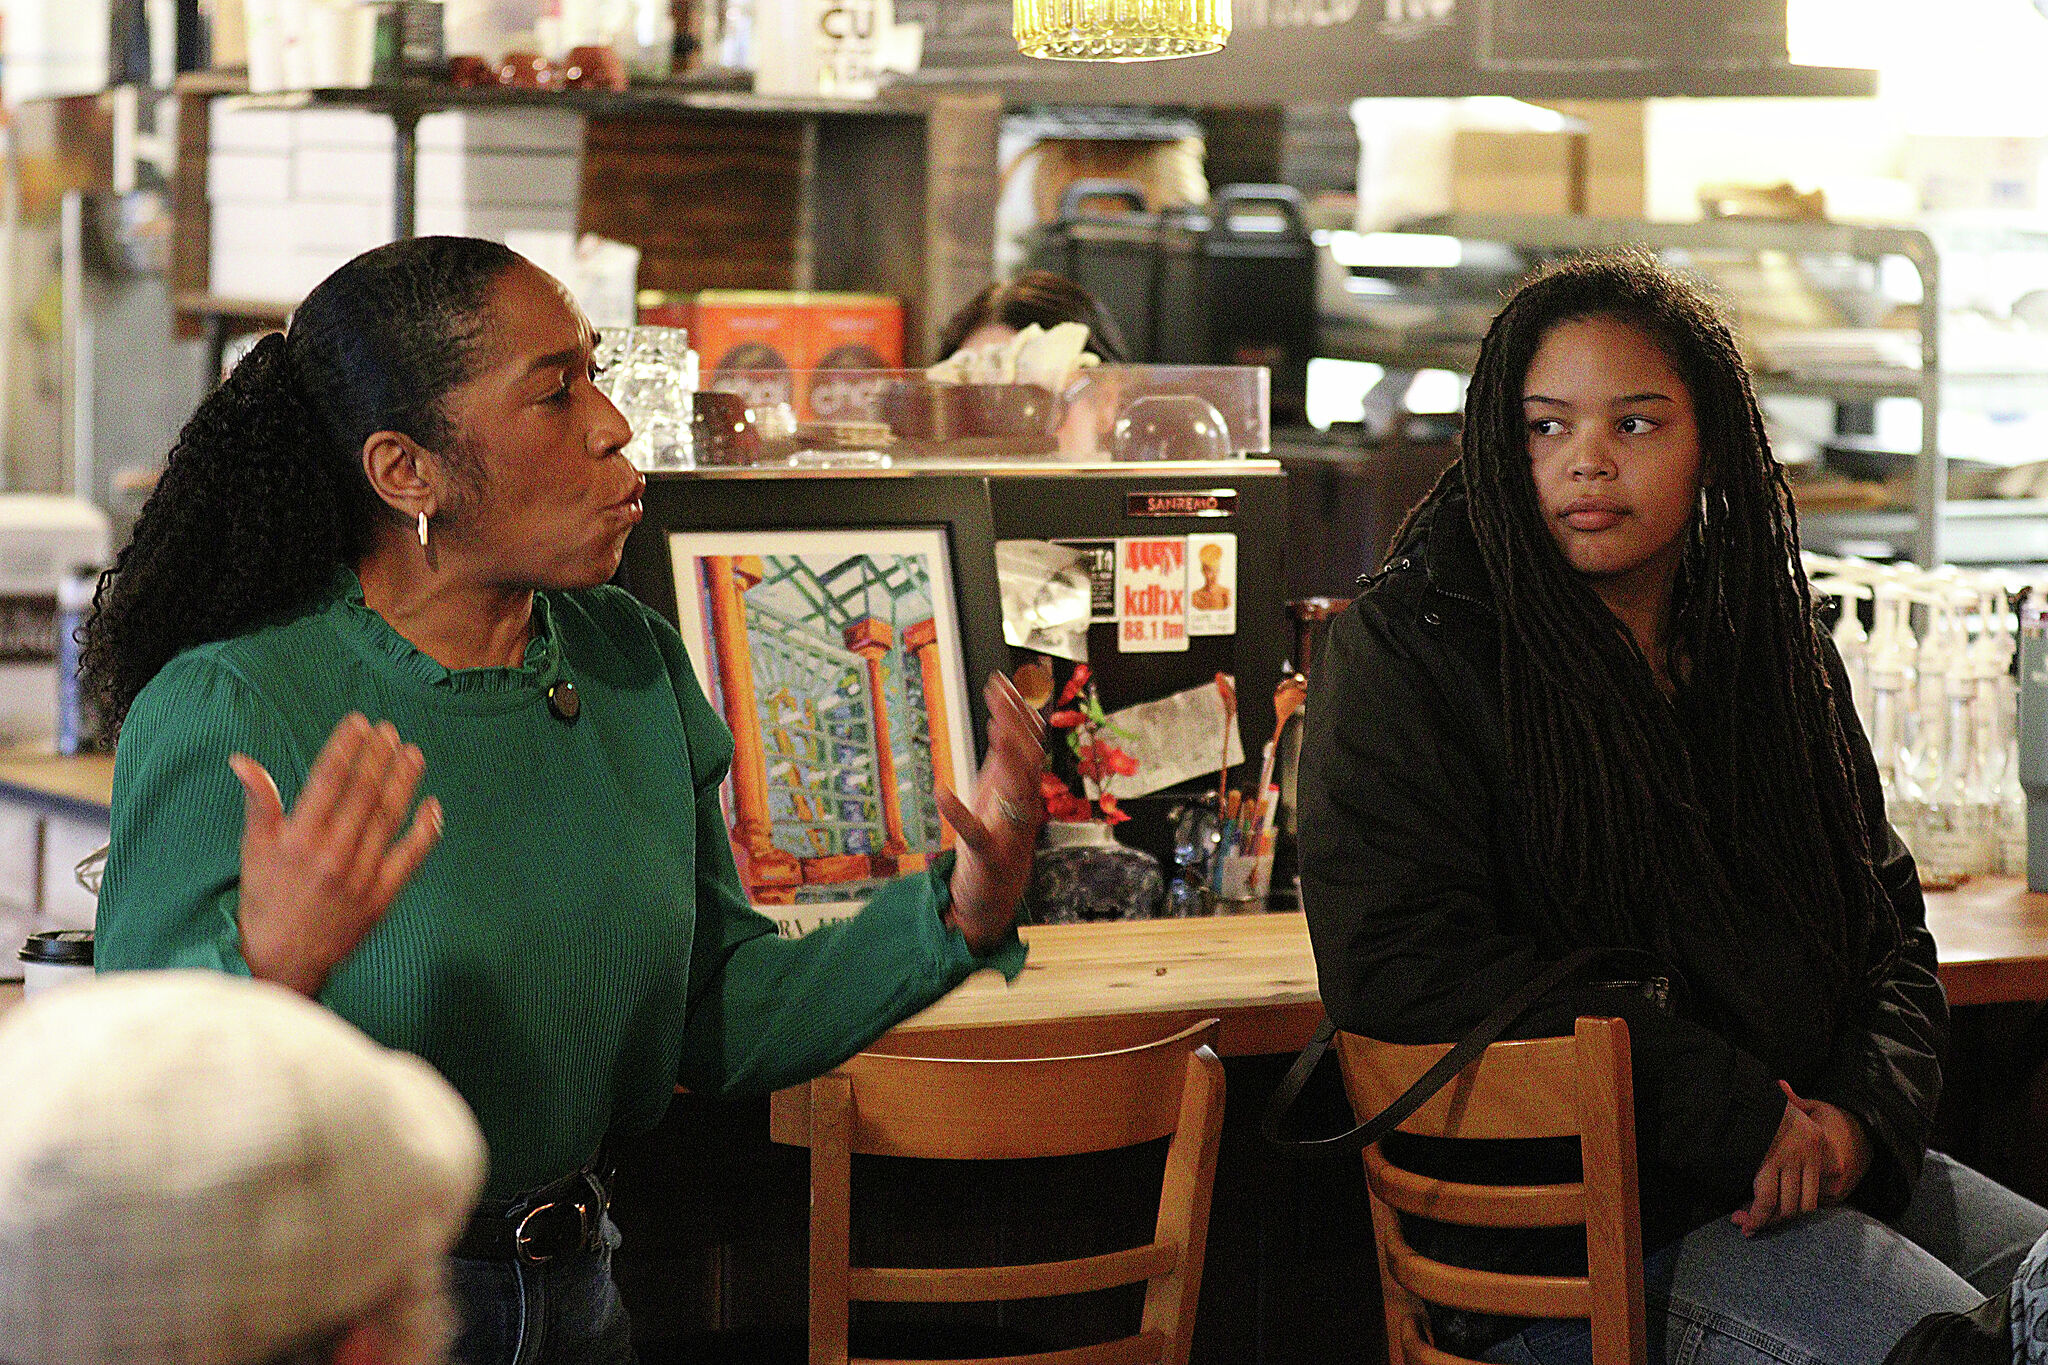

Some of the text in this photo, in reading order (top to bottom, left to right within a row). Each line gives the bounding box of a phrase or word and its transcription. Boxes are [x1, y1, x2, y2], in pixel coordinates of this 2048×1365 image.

[1147, 497, 1219, 511] SANREMO
[1123, 584, 1184, 616] kdhx
[1123, 620, 1158, 641] 88.1
